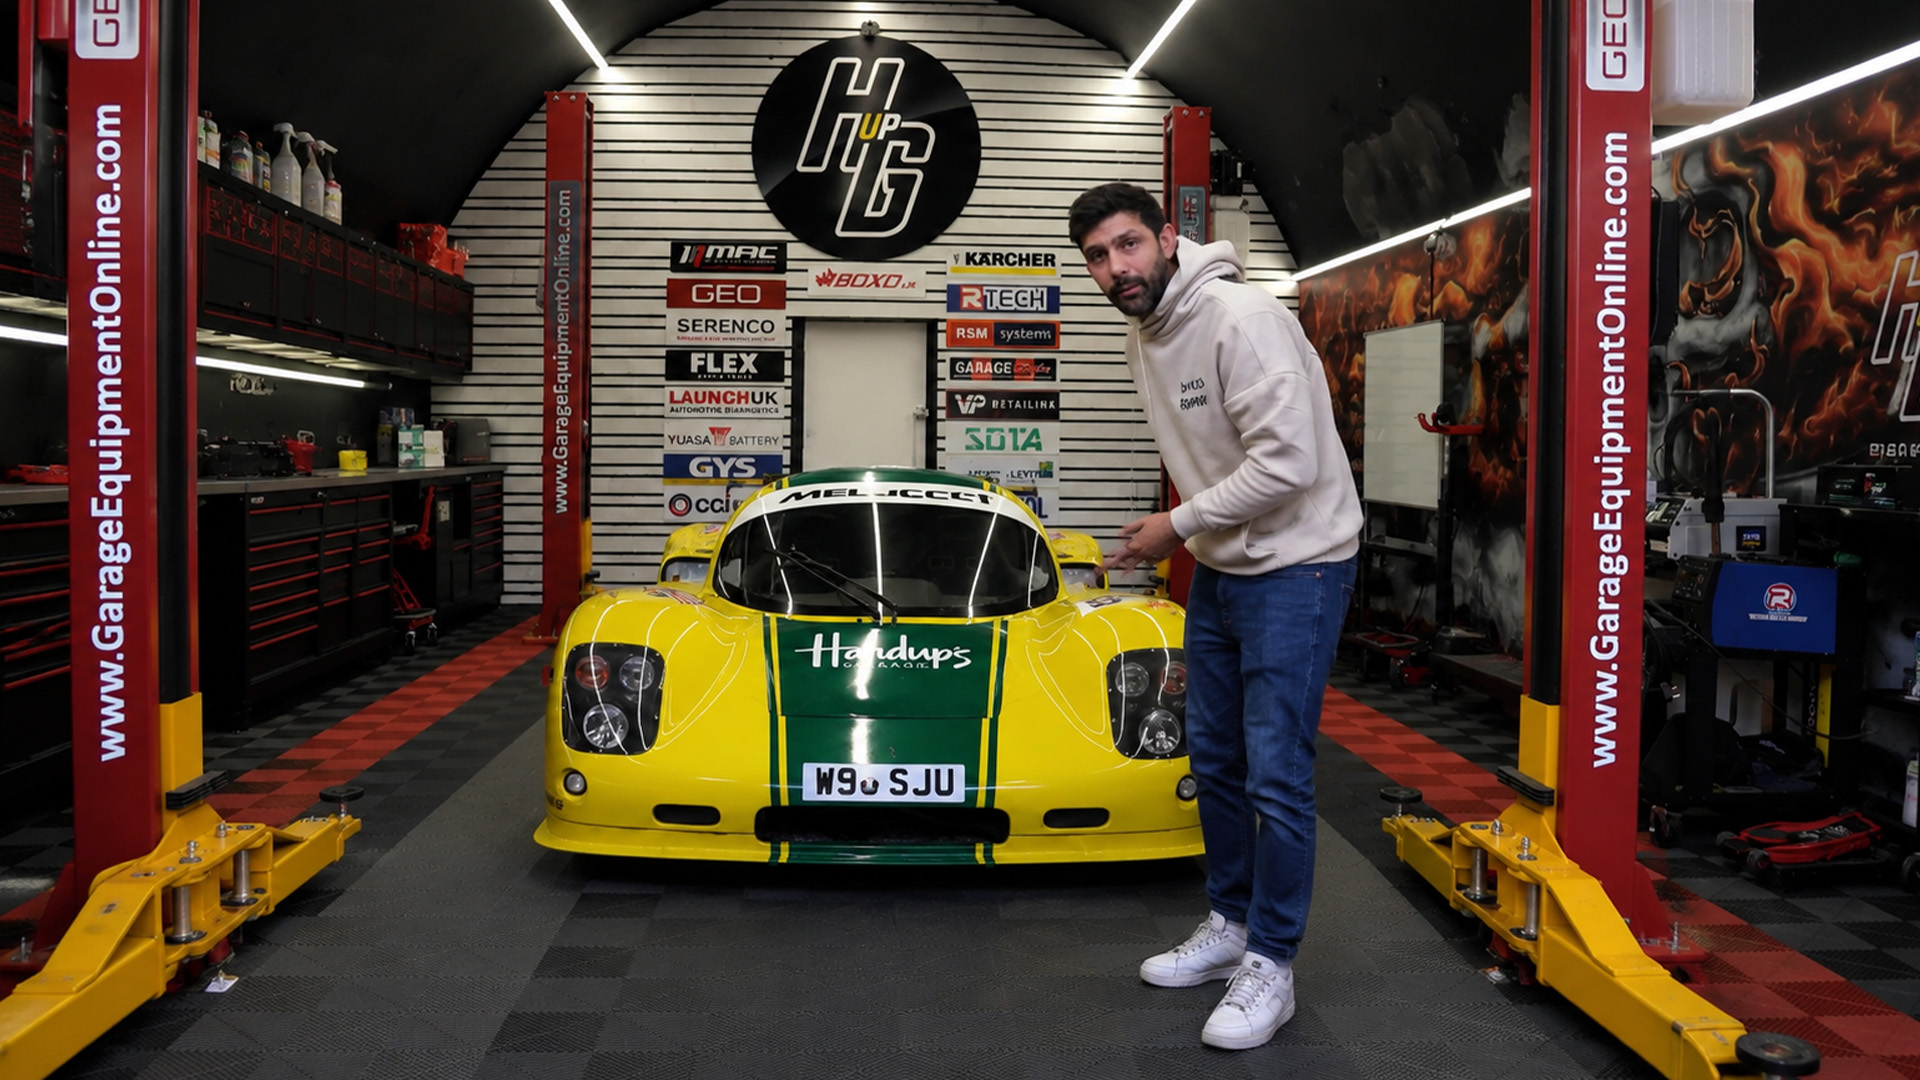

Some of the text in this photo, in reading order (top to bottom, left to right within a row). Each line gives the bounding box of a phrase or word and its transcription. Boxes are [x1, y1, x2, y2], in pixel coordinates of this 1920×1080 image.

[859, 113, 901, 140] UP
[705, 245, 778, 259] MAC
[692, 284, 761, 304] GEO
[677, 318, 775, 334] SERENCO
[956, 327, 987, 339] RSM
[552, 190, 572, 514] www.GarageEquipmentOnline.com
[690, 352, 758, 374] FLEX
[955, 361, 1012, 374] GARAGE
[955, 394, 986, 414] VP
[93, 104, 137, 761] www.GarageEquipmentOnline.com
[668, 435, 779, 446] YUASA BATTERY
[965, 427, 1042, 451] SOTA
[1589, 132, 1631, 768] www.GarageEquipmentOnline.com
[689, 456, 756, 478] GYS
[889, 768, 954, 797] SJU
